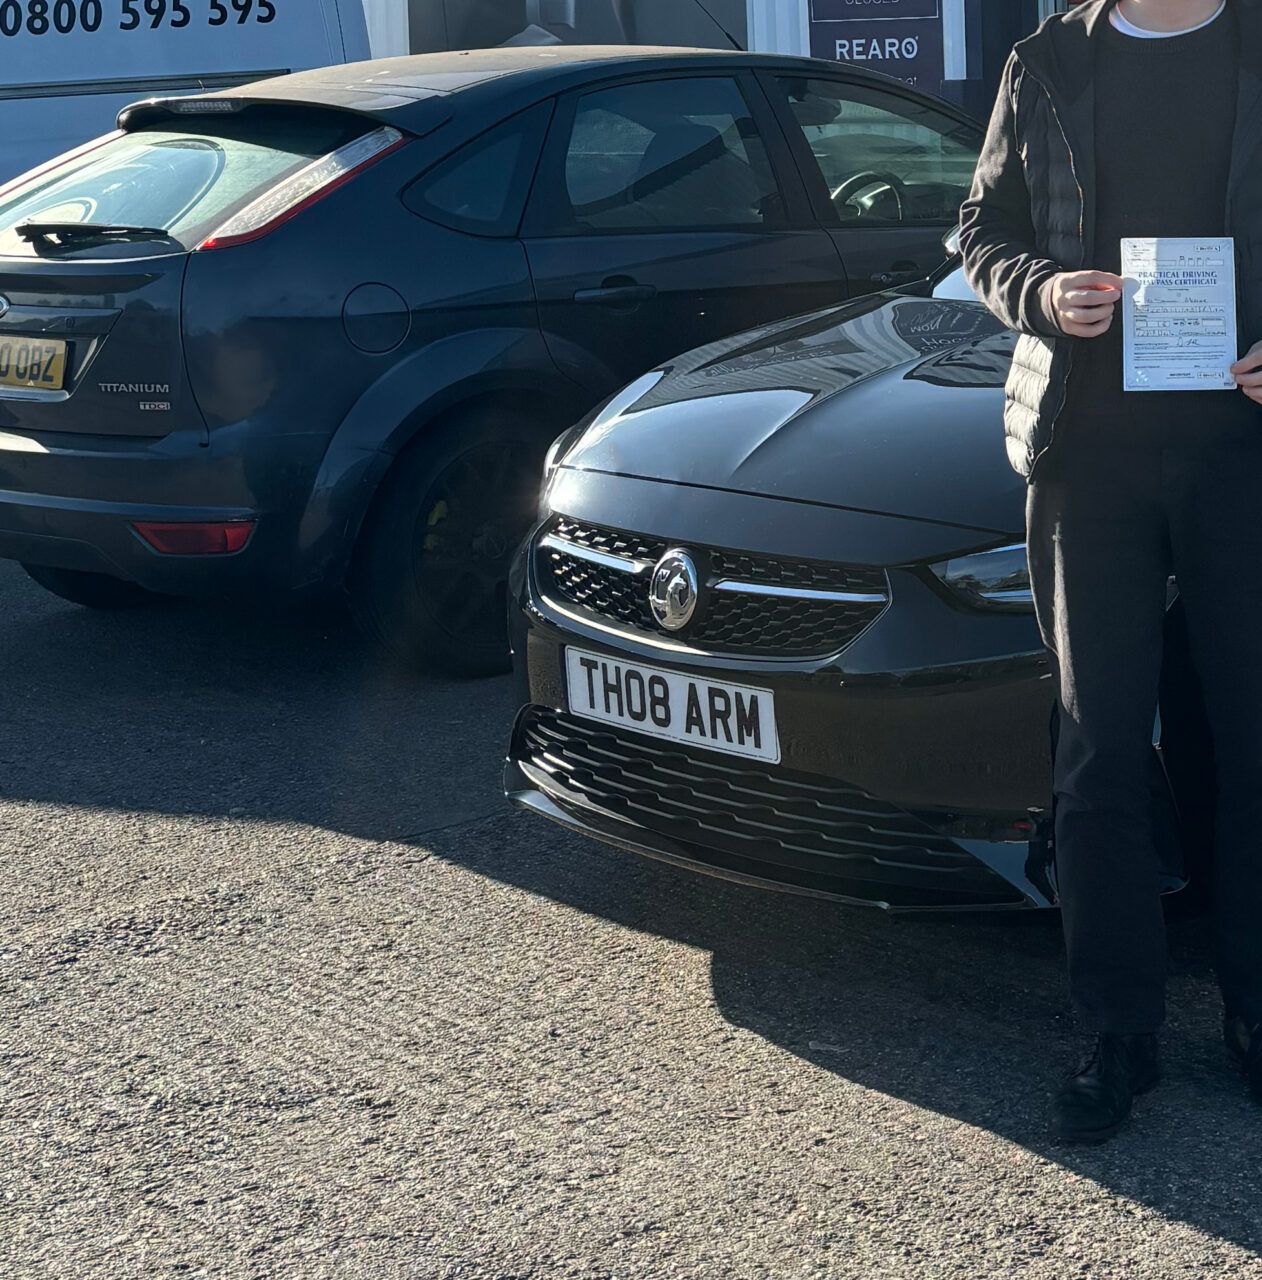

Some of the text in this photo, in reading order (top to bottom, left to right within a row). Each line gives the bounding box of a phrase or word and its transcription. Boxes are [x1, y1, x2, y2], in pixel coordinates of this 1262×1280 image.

[835, 36, 918, 60] REARO
[1138, 270, 1218, 279] PRACTICAL DRIVING
[1174, 278, 1217, 286] CERTIFICATE
[98, 382, 169, 393] TITANIUM
[579, 656, 763, 749] TH08 ARM
